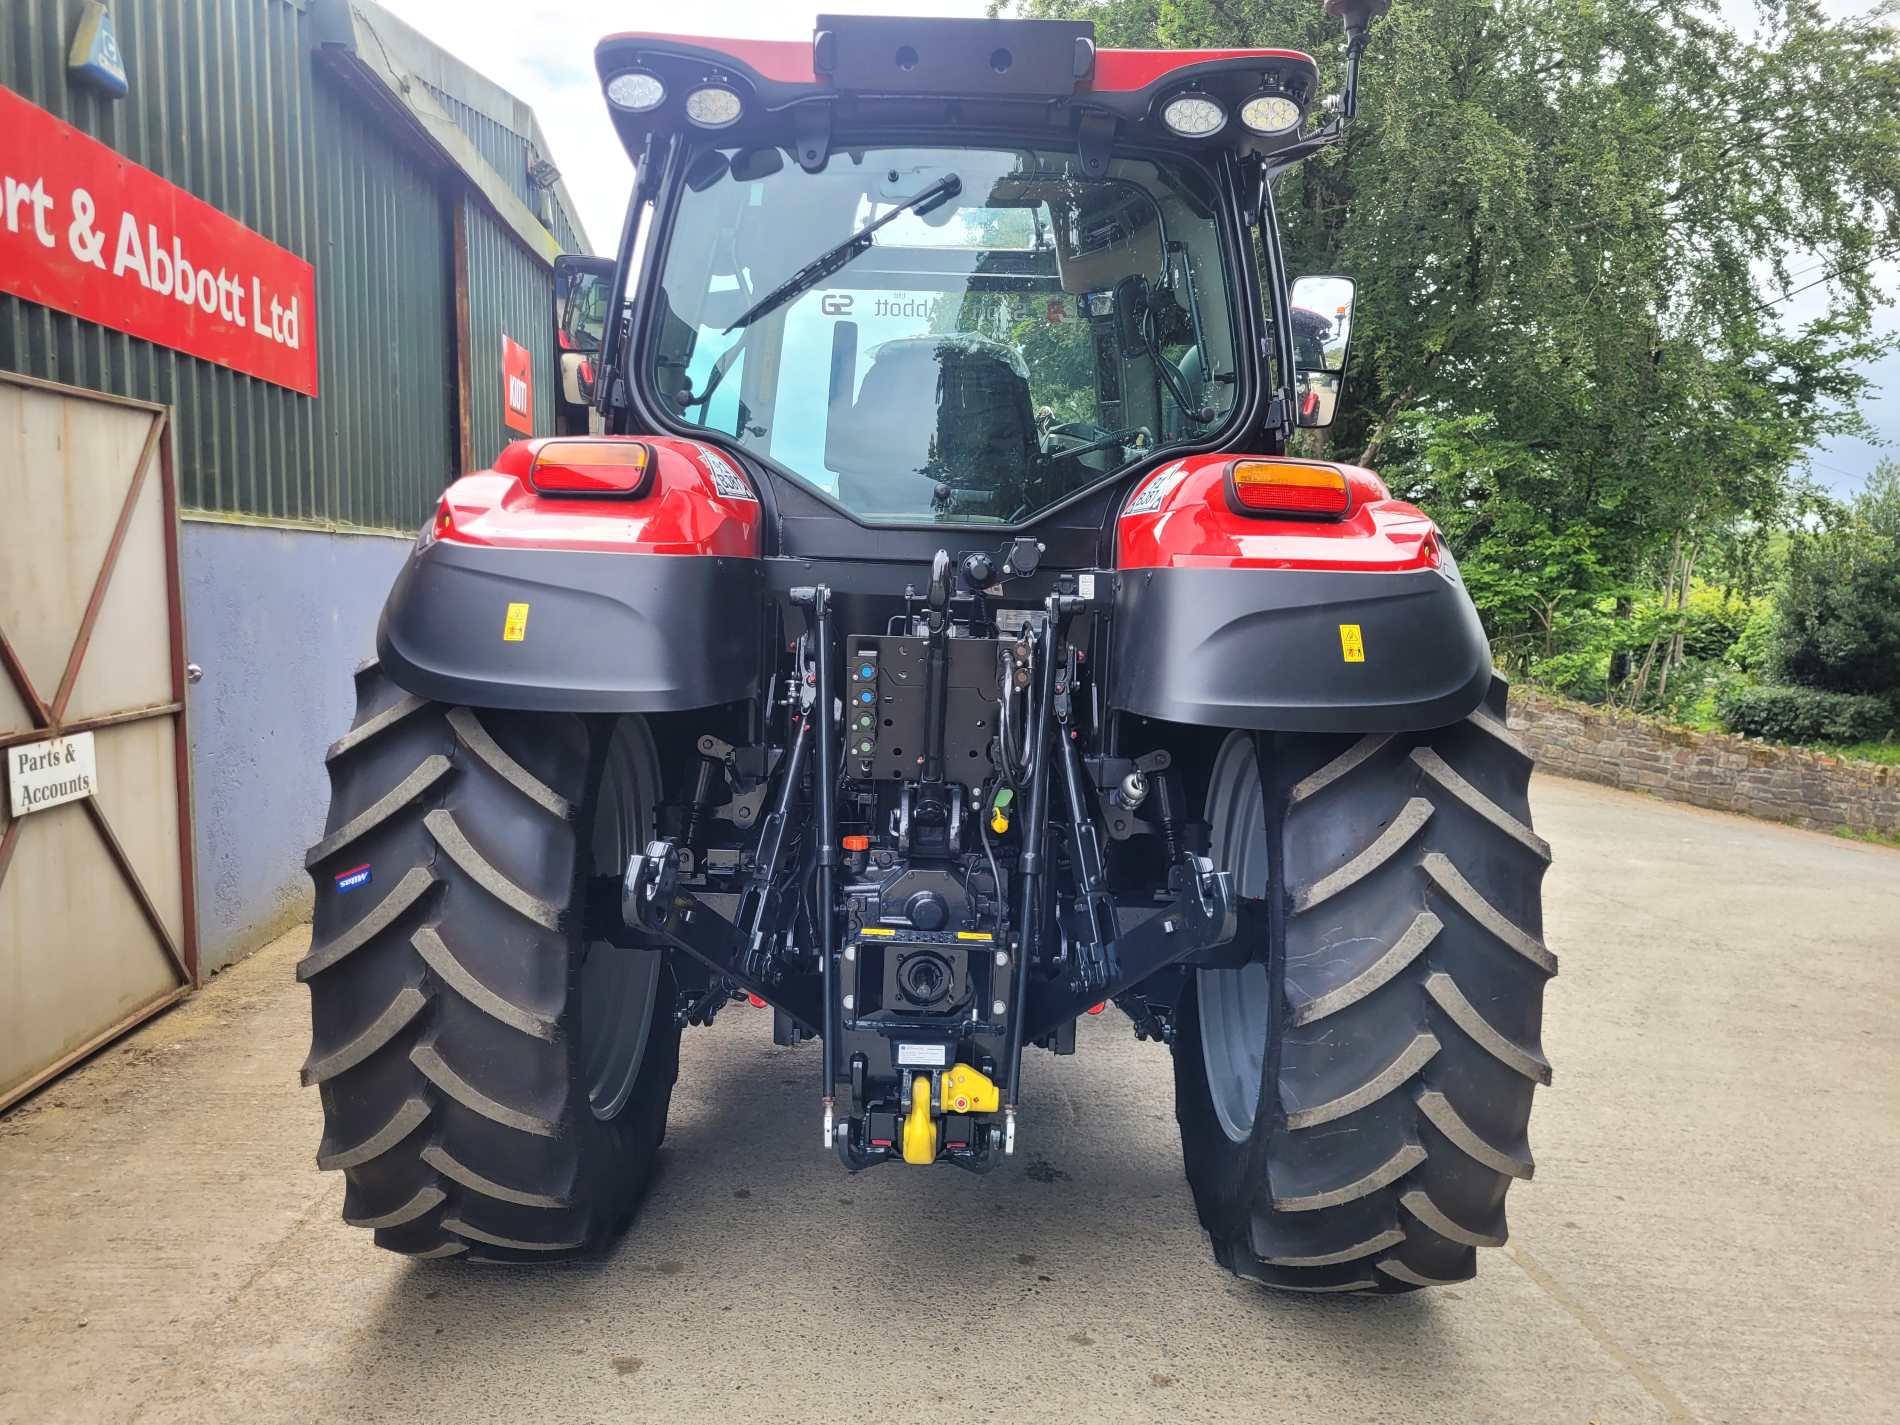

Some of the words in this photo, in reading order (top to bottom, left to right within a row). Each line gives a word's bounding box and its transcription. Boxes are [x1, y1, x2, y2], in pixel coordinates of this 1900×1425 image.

[0, 175, 56, 248] rt
[68, 188, 107, 270] &
[112, 210, 246, 328] Abbott
[252, 275, 300, 351] Ltd
[18, 748, 61, 775] Parts
[64, 743, 77, 764] &
[21, 773, 90, 807] Accounts
